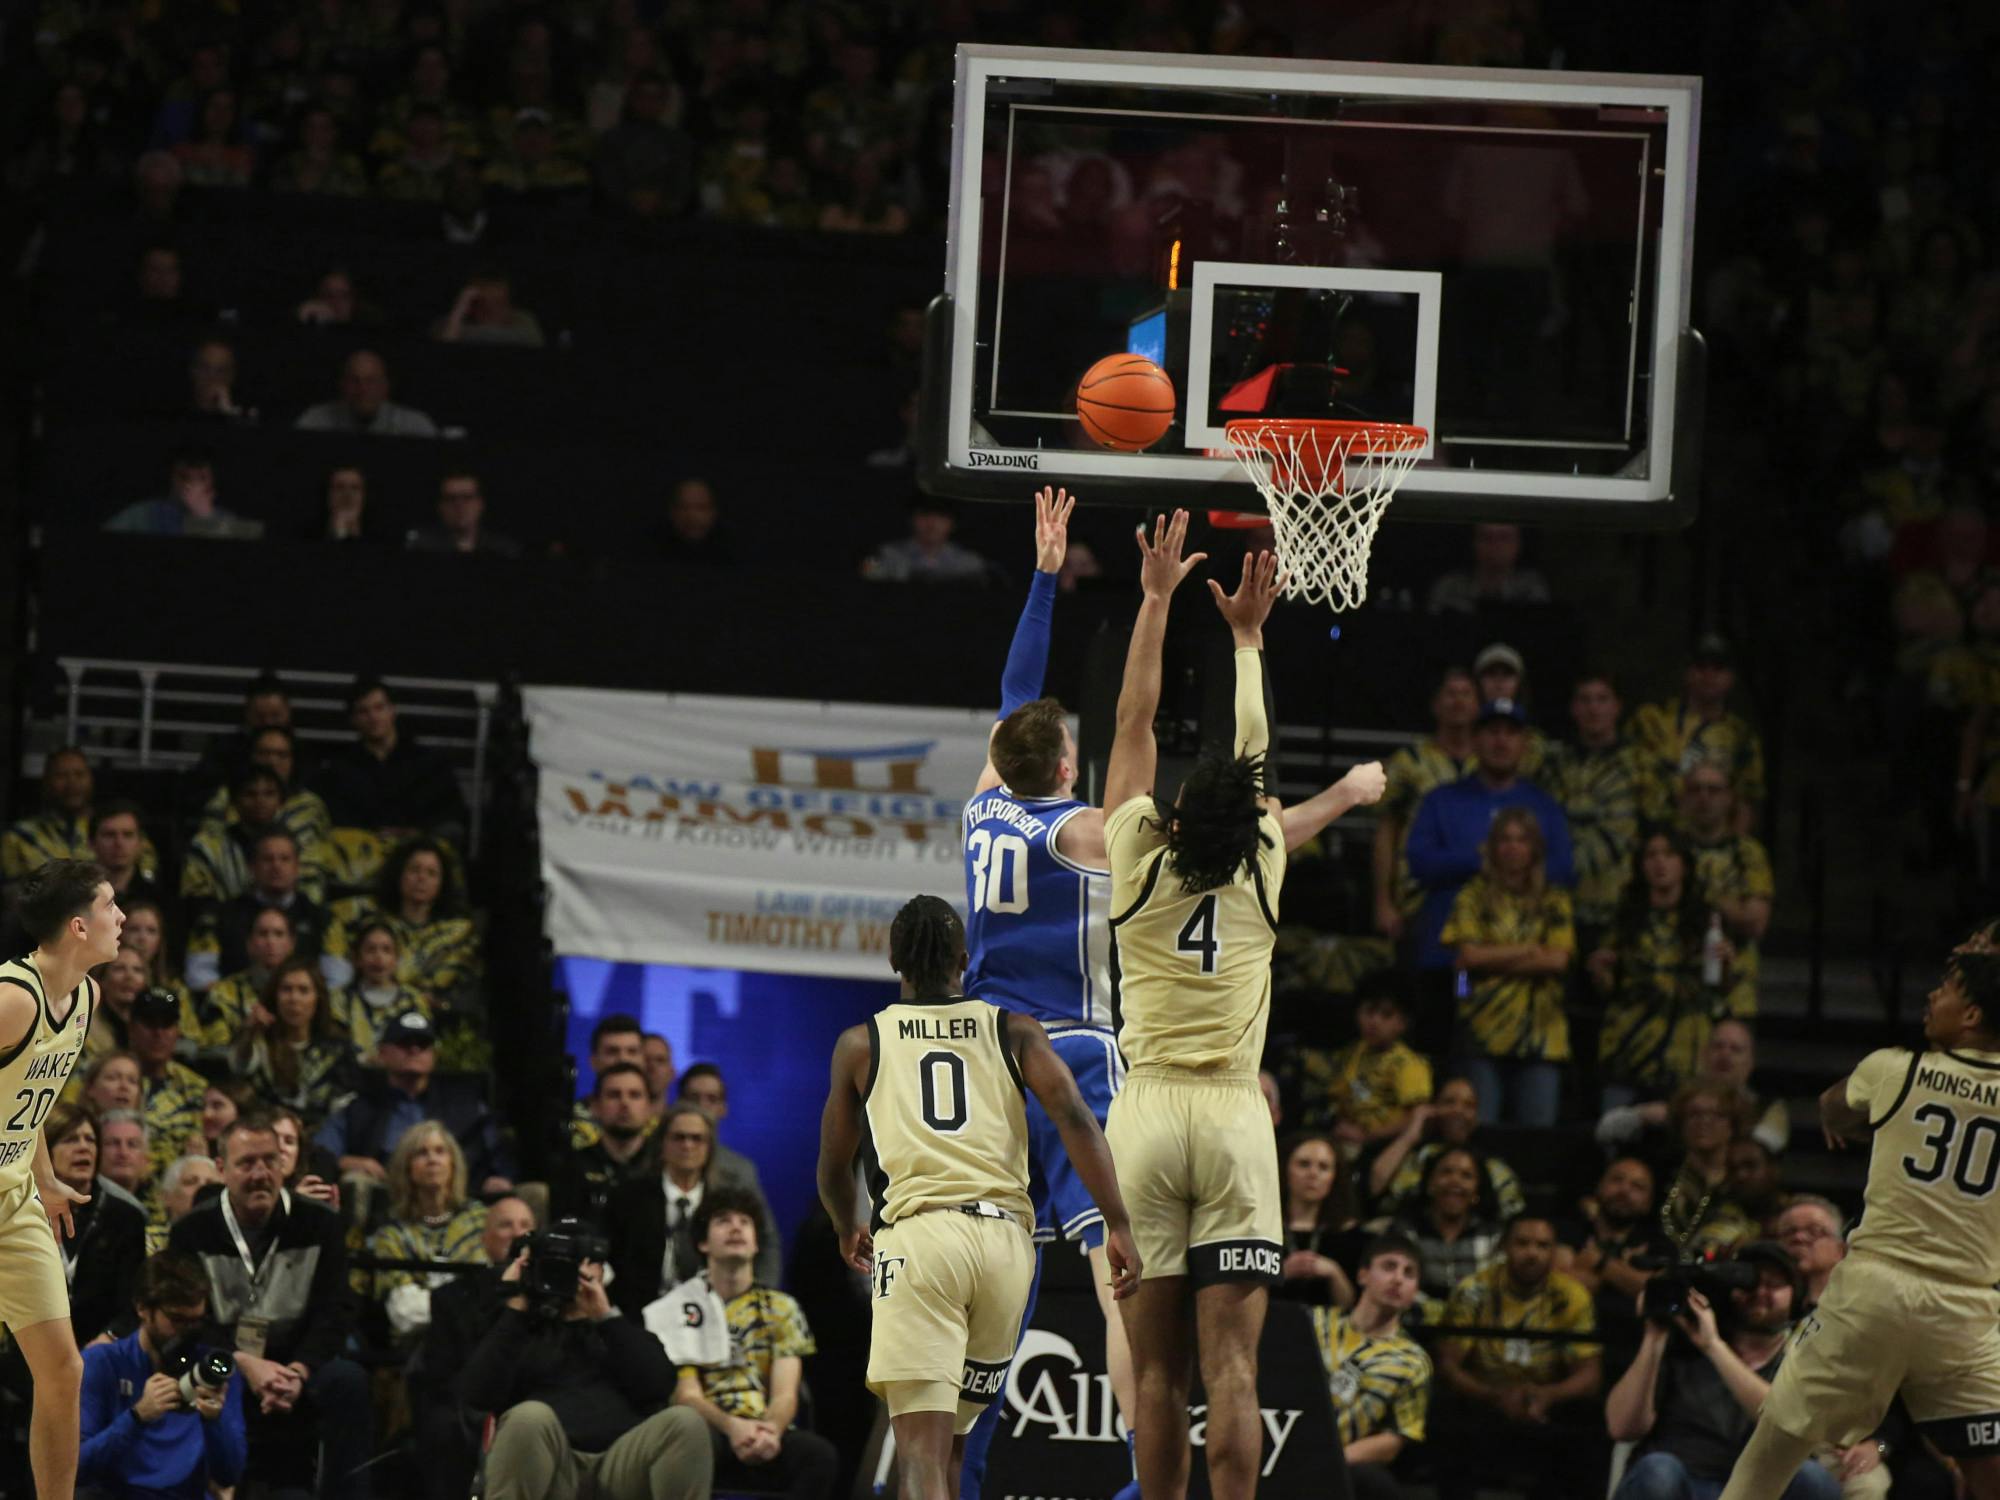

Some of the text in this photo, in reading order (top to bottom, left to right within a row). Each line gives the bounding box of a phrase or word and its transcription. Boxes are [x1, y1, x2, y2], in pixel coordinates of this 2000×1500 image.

[968, 451, 1038, 470] SPALDING
[968, 798, 1047, 840] FILIPOWSKI
[908, 842, 964, 865] Yo
[967, 828, 1030, 915] 30
[705, 911, 844, 951] TIMOTHY
[1175, 893, 1220, 974] 4
[898, 1017, 977, 1040] MILLER
[24, 1051, 76, 1081] WAKE
[1917, 1066, 1999, 1107] MONSAN
[6, 1087, 56, 1132] 20
[919, 1049, 969, 1133] 0
[1902, 1102, 2000, 1198] 30
